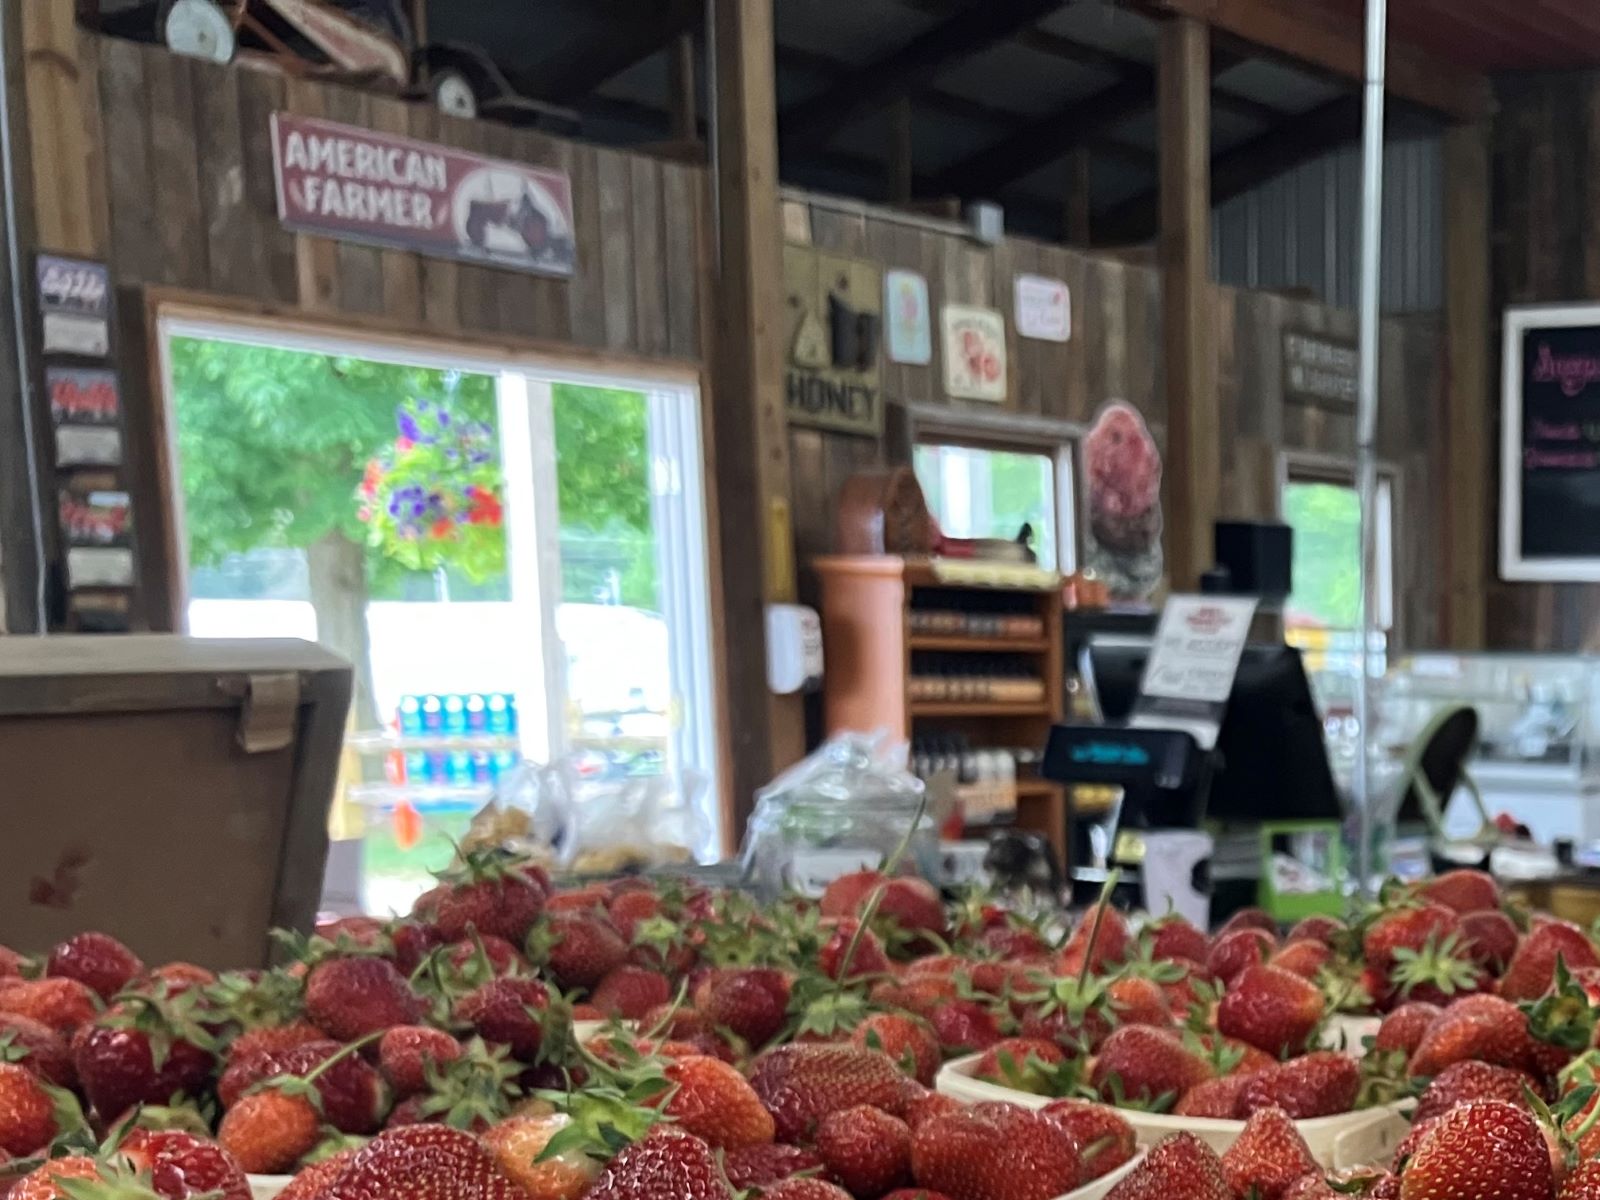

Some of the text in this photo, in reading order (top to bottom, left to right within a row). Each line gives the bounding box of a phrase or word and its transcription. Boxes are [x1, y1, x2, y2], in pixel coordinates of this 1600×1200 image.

[285, 131, 447, 192] AMERICAN
[302, 176, 433, 231] FARMER
[786, 366, 876, 421] HONEY
